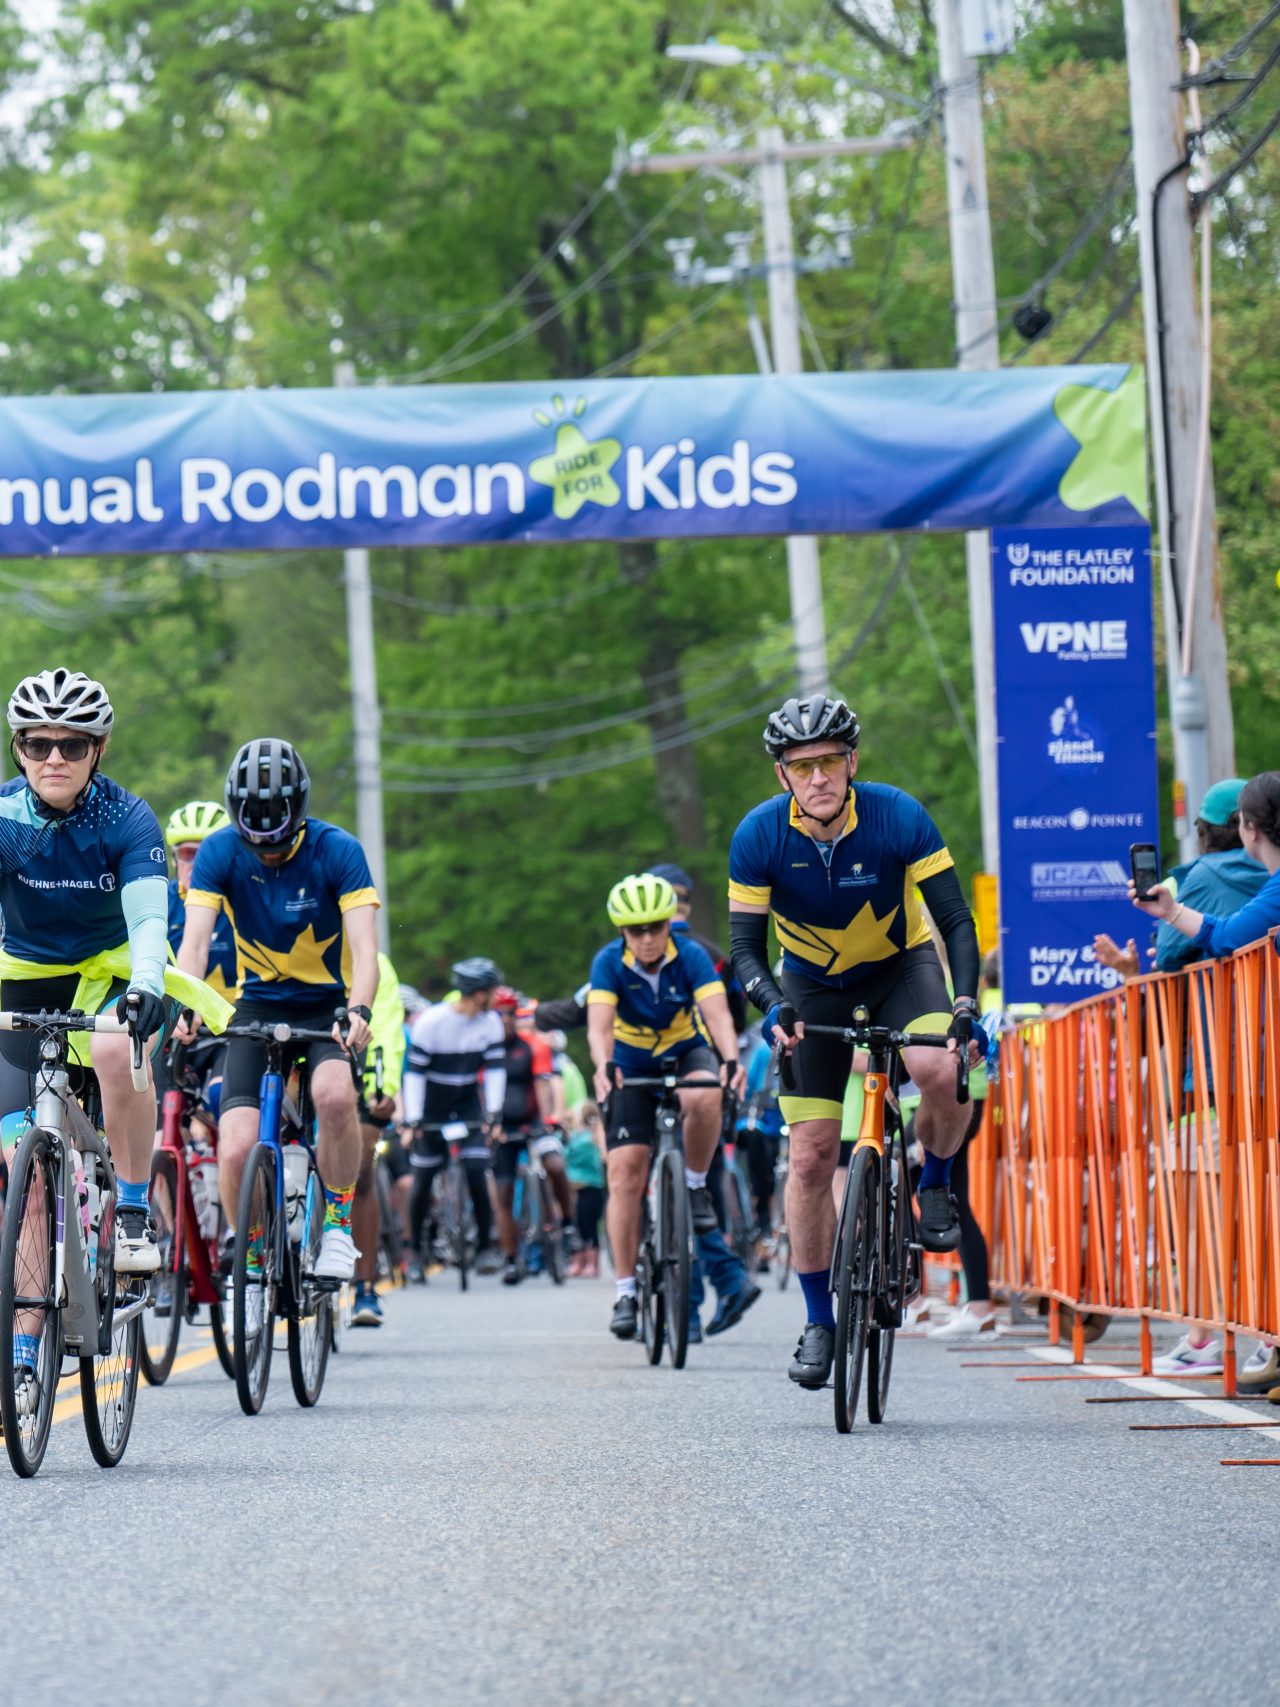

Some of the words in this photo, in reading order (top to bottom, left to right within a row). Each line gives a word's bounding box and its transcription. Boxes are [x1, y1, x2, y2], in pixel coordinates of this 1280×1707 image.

[554, 448, 602, 475] RIDE
[180, 451, 526, 524] Rodman
[626, 437, 798, 511] Kids
[562, 474, 604, 497] FOR
[1031, 550, 1063, 566] THE
[1065, 548, 1134, 566] FLATLEY
[1009, 565, 1134, 586] FOUNDATION
[1019, 620, 1128, 653] VPNE
[1012, 816, 1069, 830] BEACON
[1090, 812, 1144, 828] POINTE
[17, 873, 97, 890] KUEHNE+NAGEL
[1029, 945, 1079, 966] Mary
[1080, 944, 1098, 963] &
